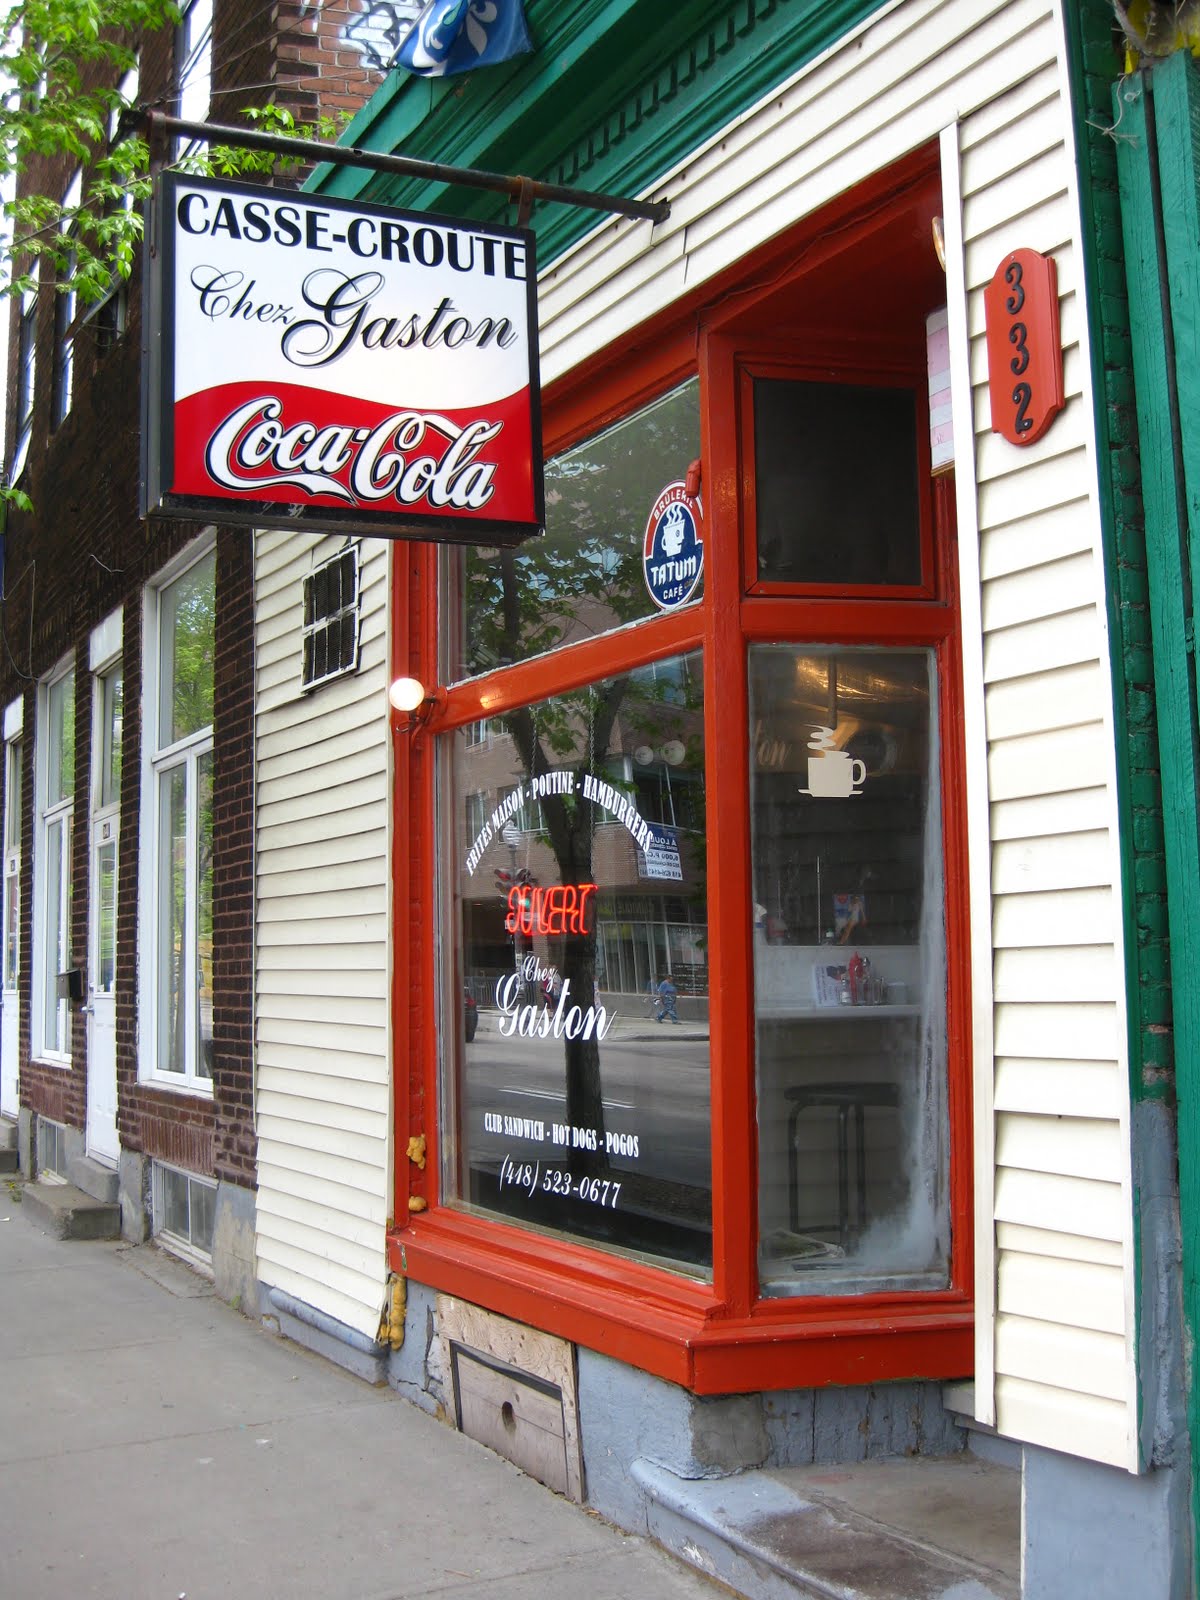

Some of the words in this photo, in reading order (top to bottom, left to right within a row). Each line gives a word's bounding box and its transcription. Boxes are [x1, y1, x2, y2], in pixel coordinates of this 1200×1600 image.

[176, 193, 528, 282] CASSE-CROUTE
[190, 264, 296, 324] Chez
[280, 268, 518, 369] Gaston
[1005, 262, 1033, 434] 332
[204, 396, 504, 511] Coca-Cola
[651, 555, 697, 587] TATUM
[663, 583, 683, 600] CAFÉ
[465, 823, 492, 876] FRITES
[491, 786, 524, 831] MAISON
[532, 771, 574, 800] POUTINE
[583, 774, 654, 853] HAMBURGERS
[507, 884, 595, 935] OUVERT
[522, 955, 557, 992] Chez
[495, 974, 617, 1040] Gaston
[484, 1112, 502, 1134] CLUB
[504, 1115, 545, 1142] SANDWICH
[552, 1123, 570, 1146] HOT
[572, 1126, 597, 1151] DOGS
[605, 1131, 640, 1158] POGOS
[499, 1153, 540, 1198] (418)
[542, 1169, 622, 1209] 523-0677
